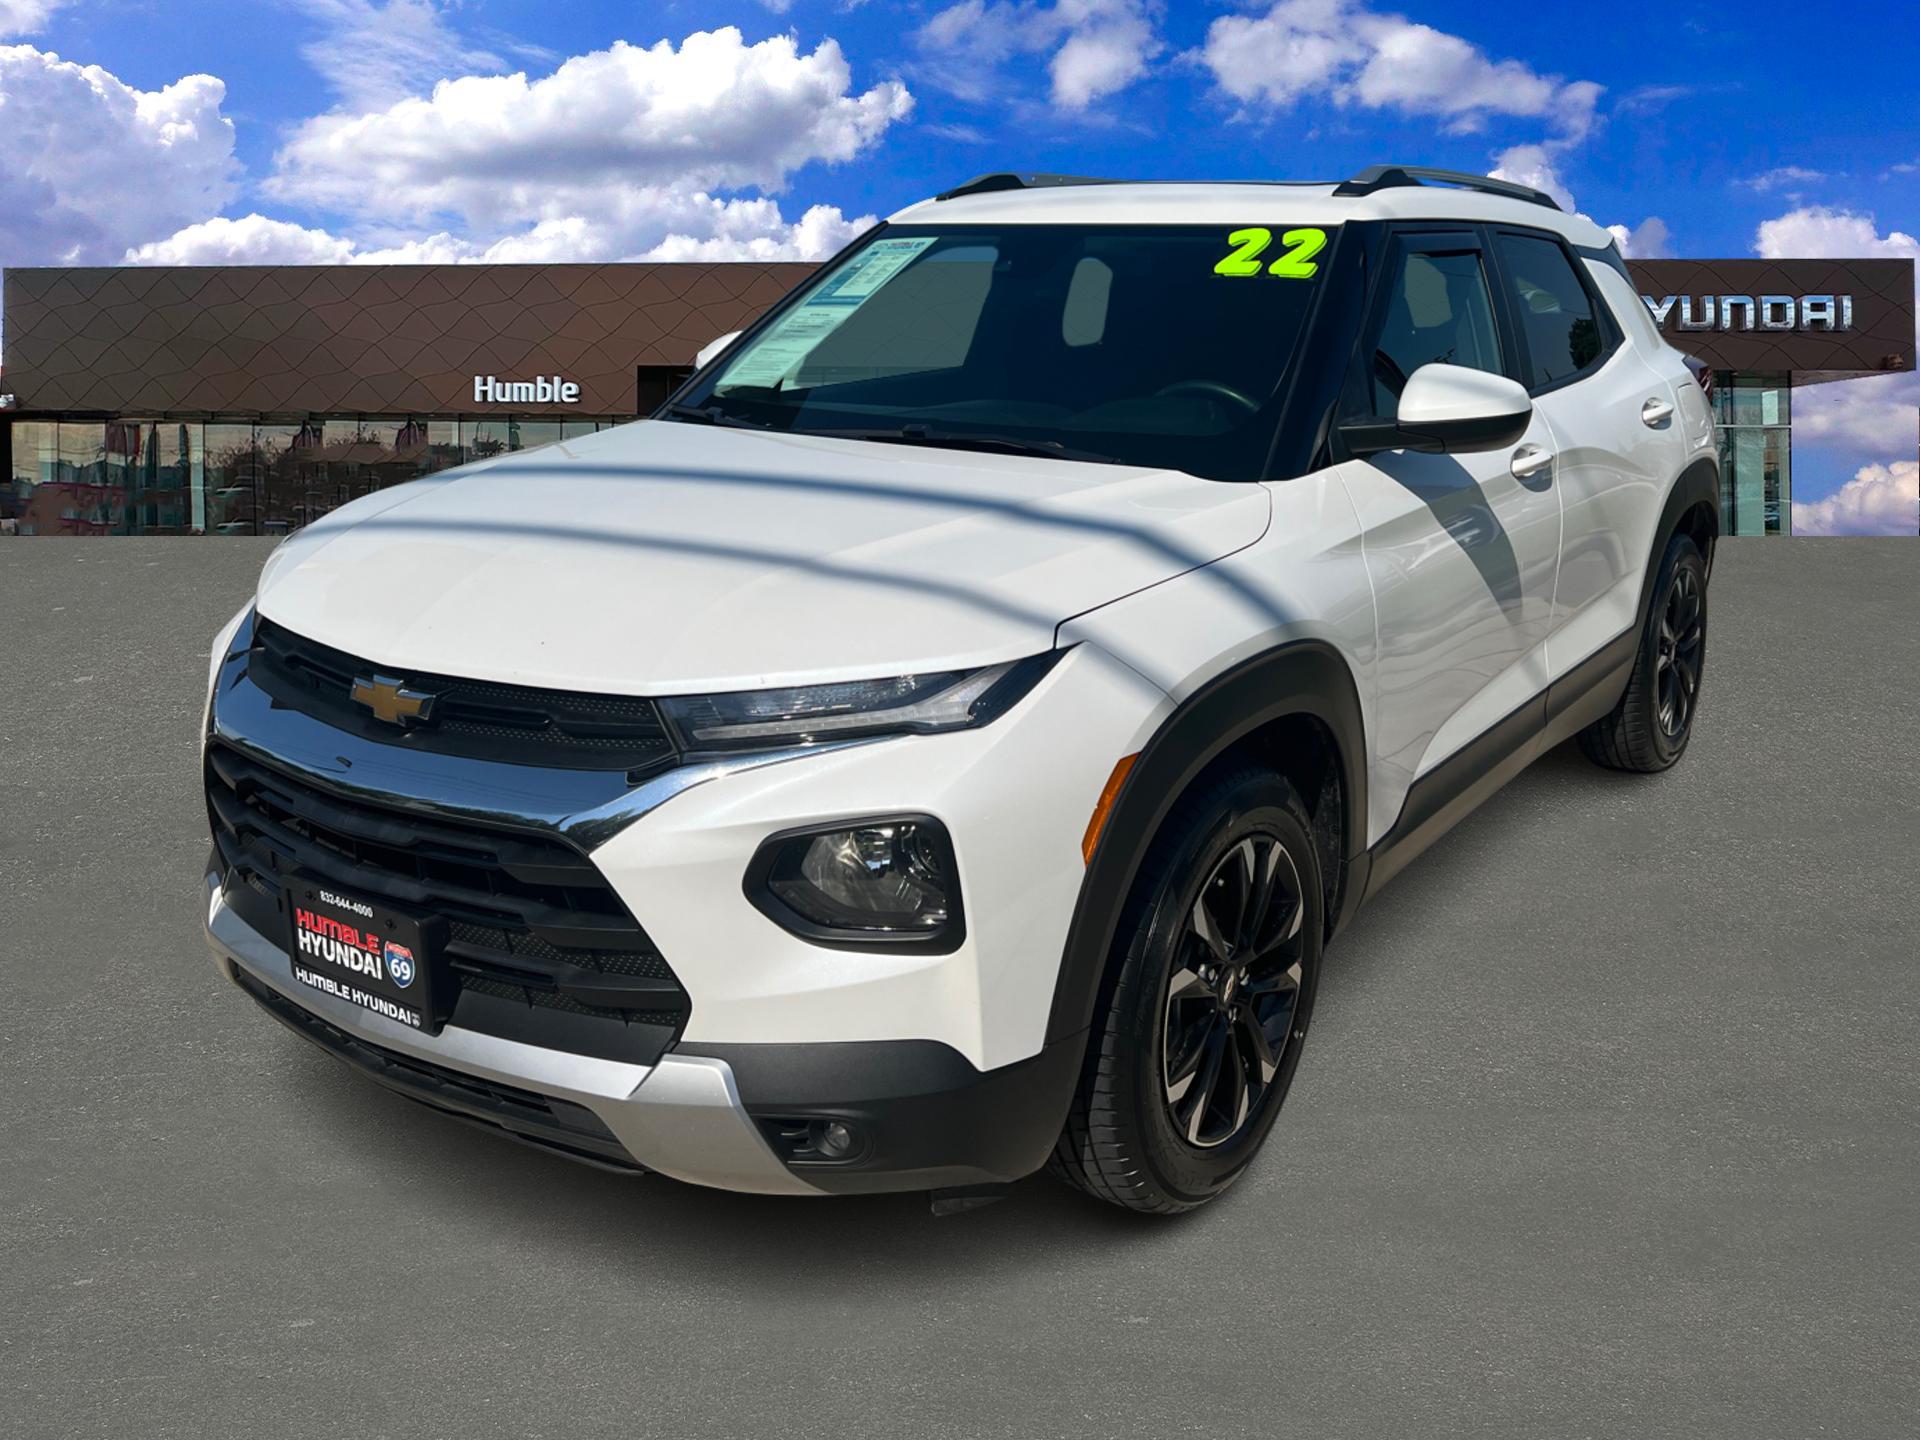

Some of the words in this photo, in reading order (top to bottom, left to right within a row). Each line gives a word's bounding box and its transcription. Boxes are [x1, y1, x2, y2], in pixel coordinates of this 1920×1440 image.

[1213, 227, 1327, 279] 22
[1640, 295, 1852, 332] YUNDAI
[474, 375, 580, 403] Humble
[296, 907, 381, 955] HUMBLE
[298, 927, 383, 980] HYUNDAI
[391, 958, 411, 980] 69
[296, 966, 351, 1000] HUMBLE
[352, 988, 412, 1025] HYUNDAI
